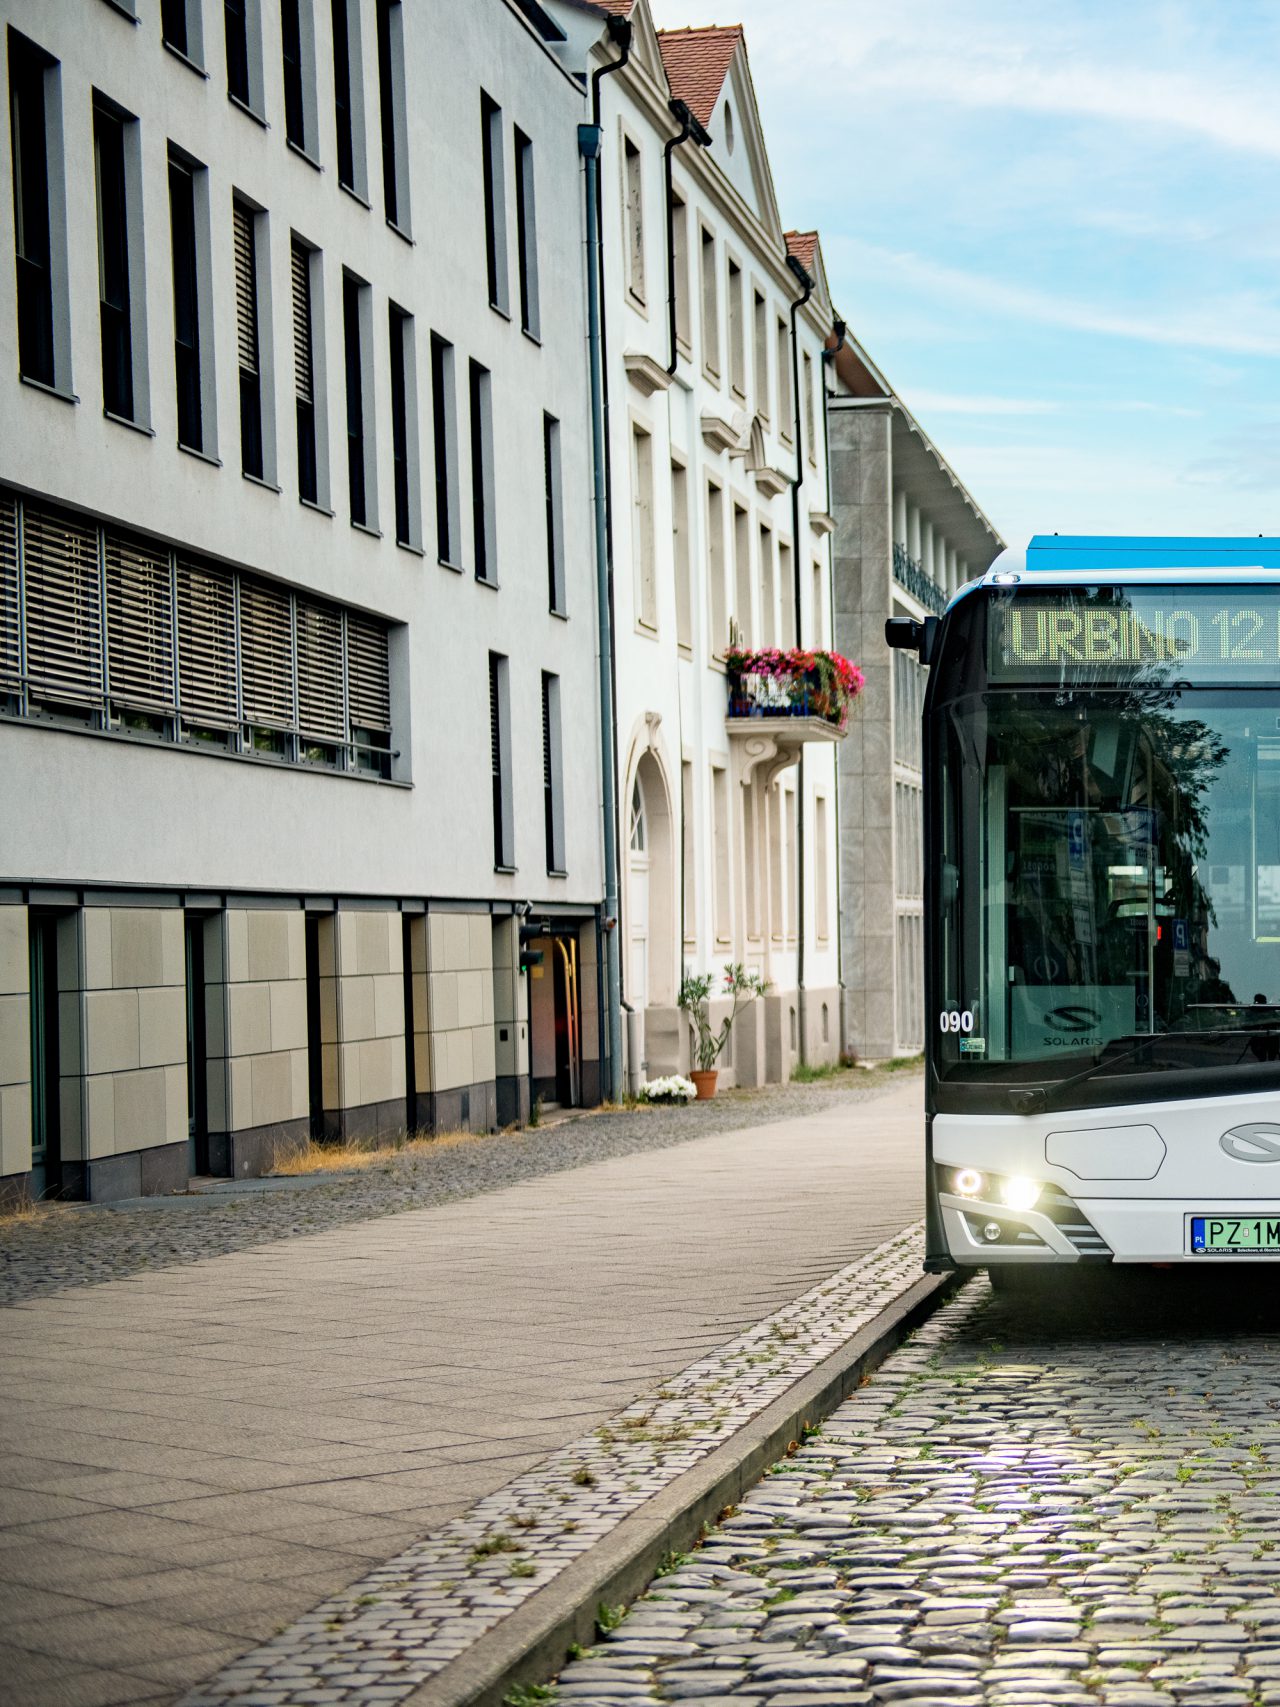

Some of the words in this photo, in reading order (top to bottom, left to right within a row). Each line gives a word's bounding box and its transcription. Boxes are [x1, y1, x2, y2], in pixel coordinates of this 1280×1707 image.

[1012, 610, 1199, 661] URBINO
[1212, 610, 1264, 659] 12
[940, 1011, 973, 1032] 090
[1043, 1037, 1103, 1046] SOLARIS
[1210, 1222, 1241, 1245] PZ
